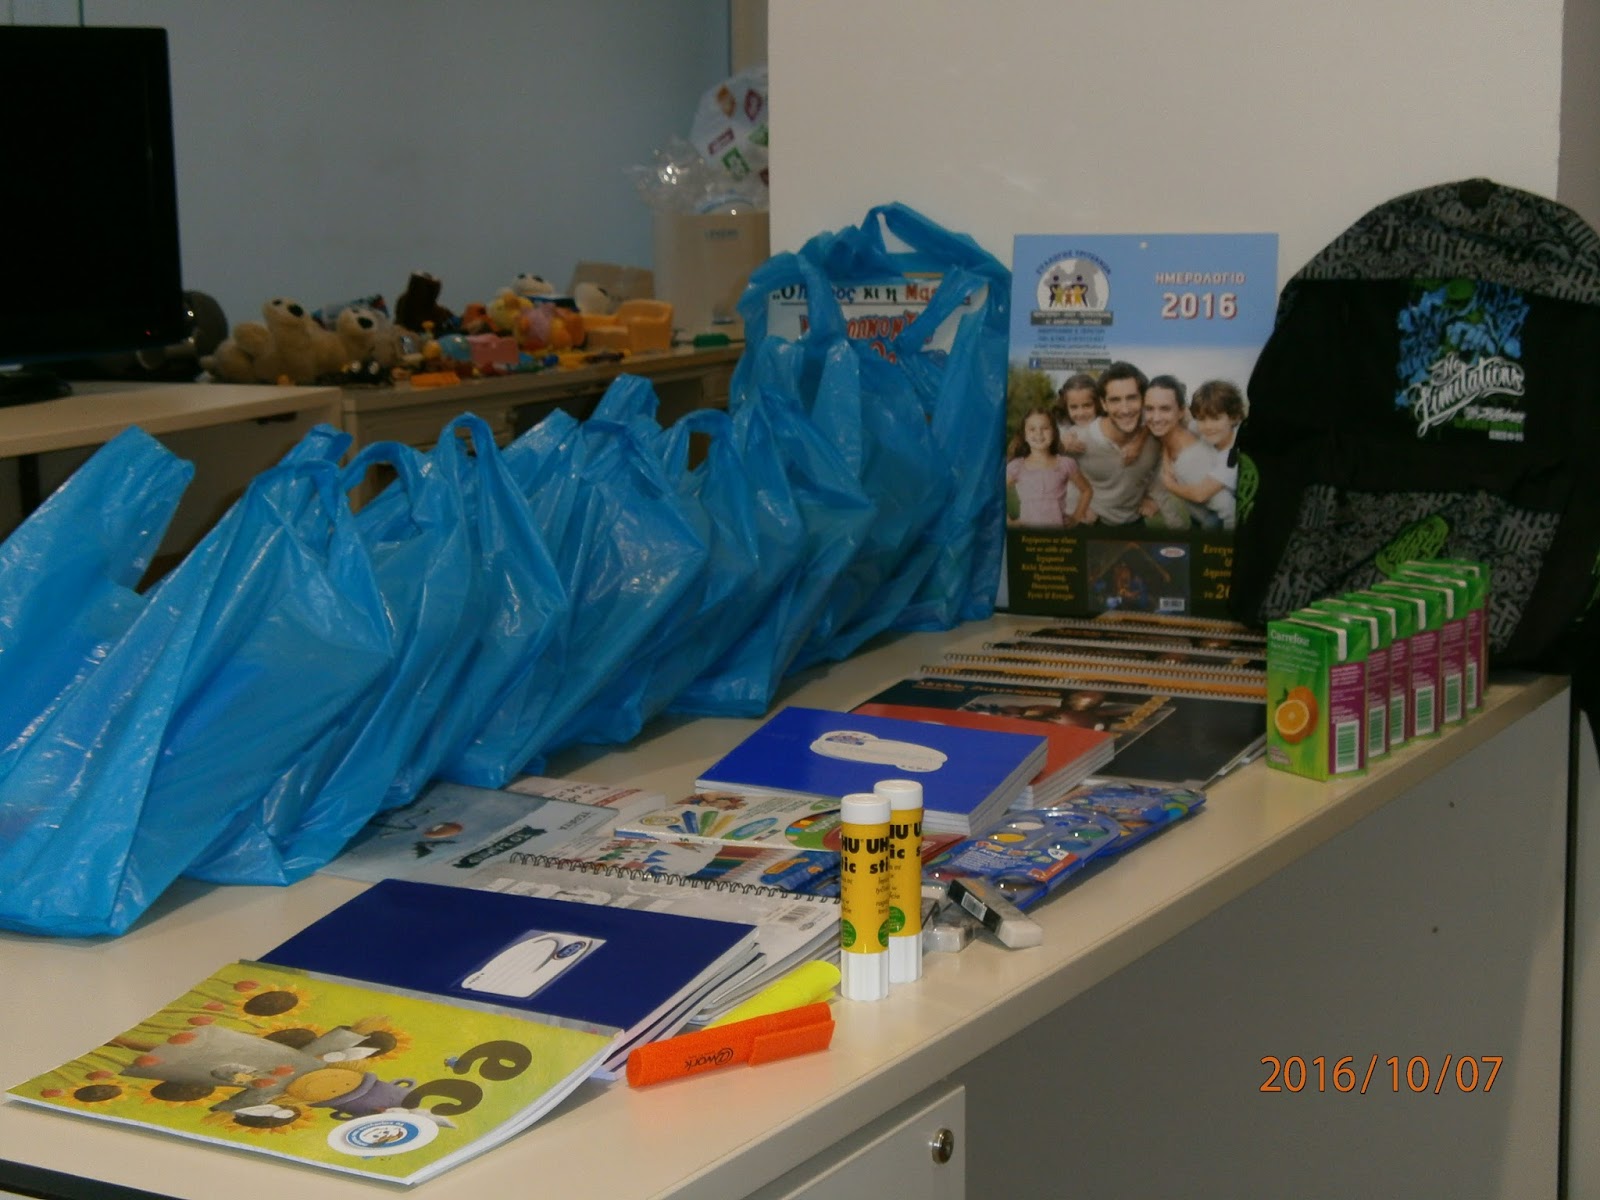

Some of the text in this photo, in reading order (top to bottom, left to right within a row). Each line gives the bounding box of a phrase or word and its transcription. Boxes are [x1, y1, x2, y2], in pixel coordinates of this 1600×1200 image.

[1155, 271, 1246, 285] ΗΜΕΡΟΛΟΓΙΟ
[1161, 291, 1239, 321] 2016
[1270, 630, 1310, 647] Carrefour
[866, 836, 889, 854] UH
[869, 856, 889, 874] sti
[685, 1047, 734, 1071] @work
